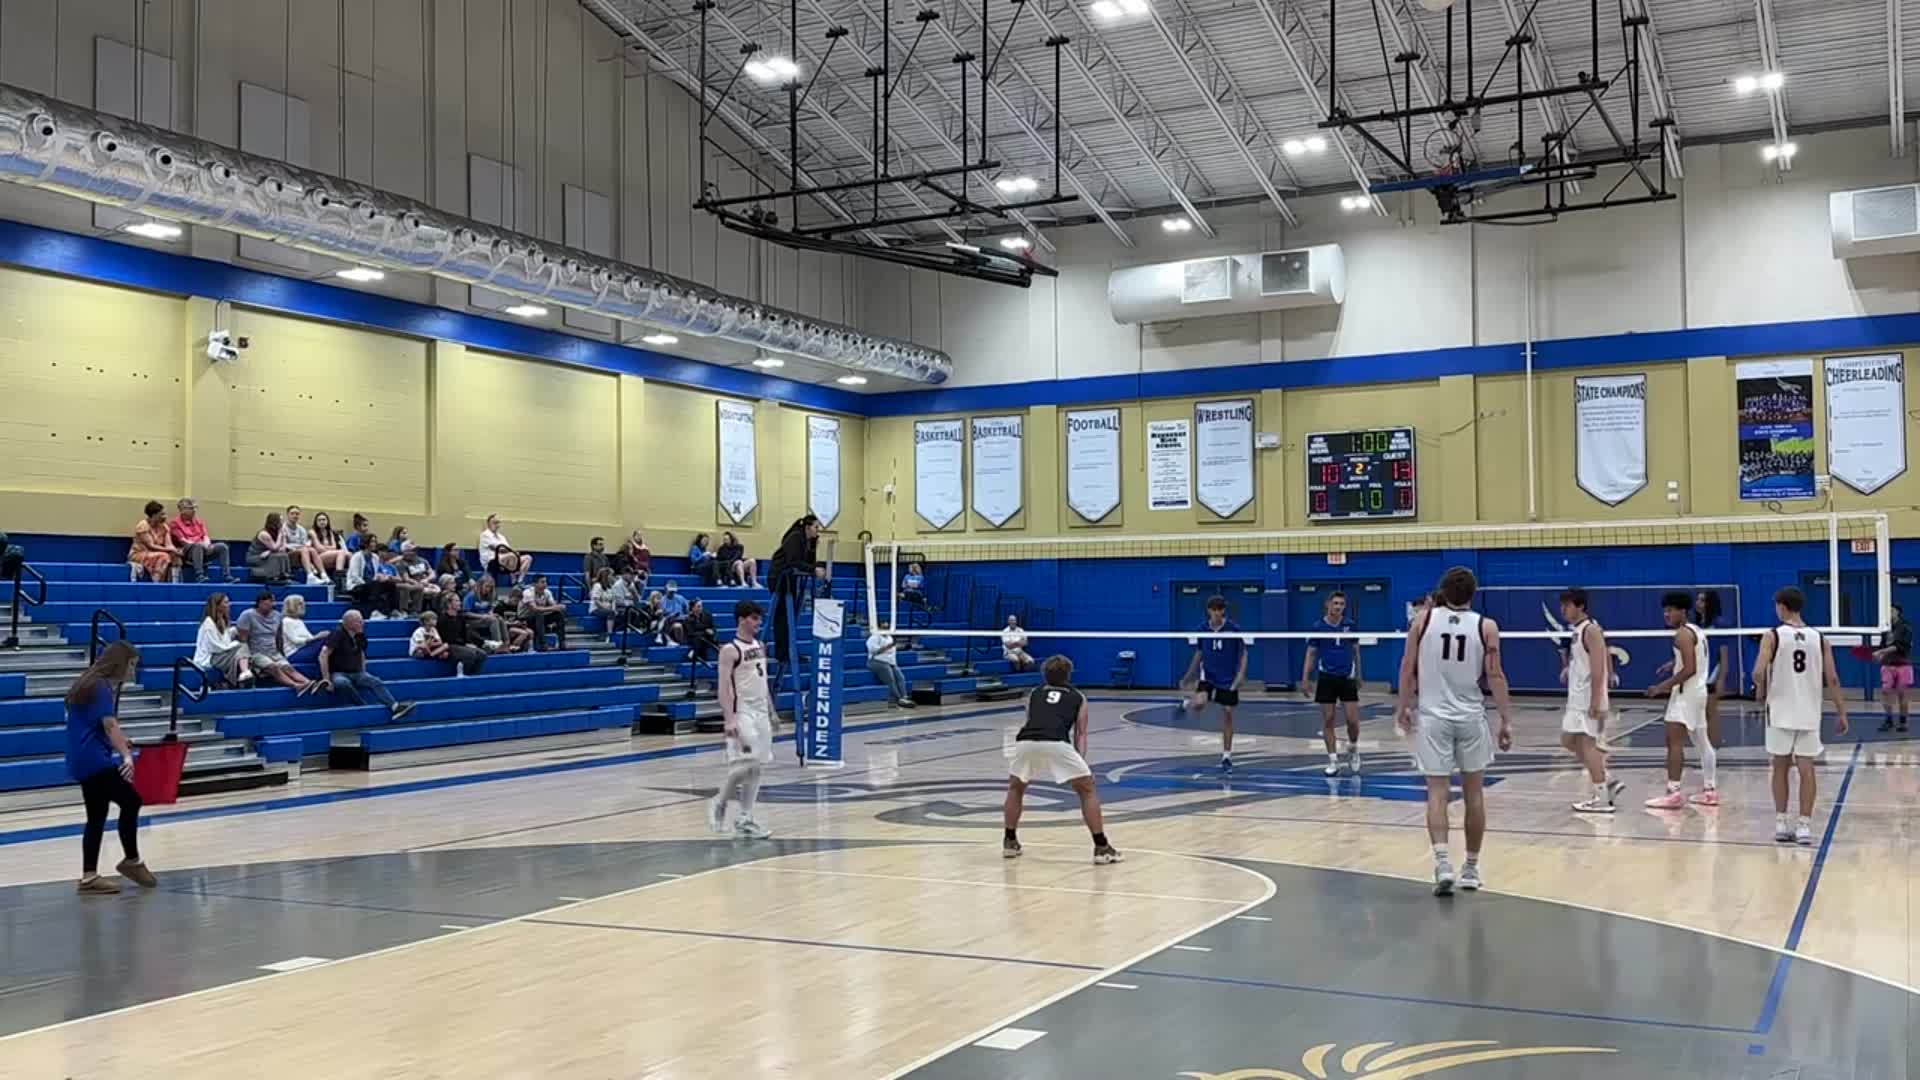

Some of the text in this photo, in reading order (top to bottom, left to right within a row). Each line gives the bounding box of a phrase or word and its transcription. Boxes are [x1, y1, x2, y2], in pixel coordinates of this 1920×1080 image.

[1827, 363, 1904, 386] CHEERLEADING
[1576, 381, 1645, 403] STATE CHAMPIONS
[1196, 405, 1252, 424] WRESTLING
[972, 423, 1023, 440] BASKETBALL
[1067, 415, 1120, 434] FOOTBALL
[915, 427, 963, 444] BASKETBALL
[1355, 463, 1365, 475] 2
[1441, 633, 1466, 661] 11
[1793, 649, 1806, 673] 8
[815, 642, 832, 757] MENENDEZ
[1046, 690, 1062, 704] 9
